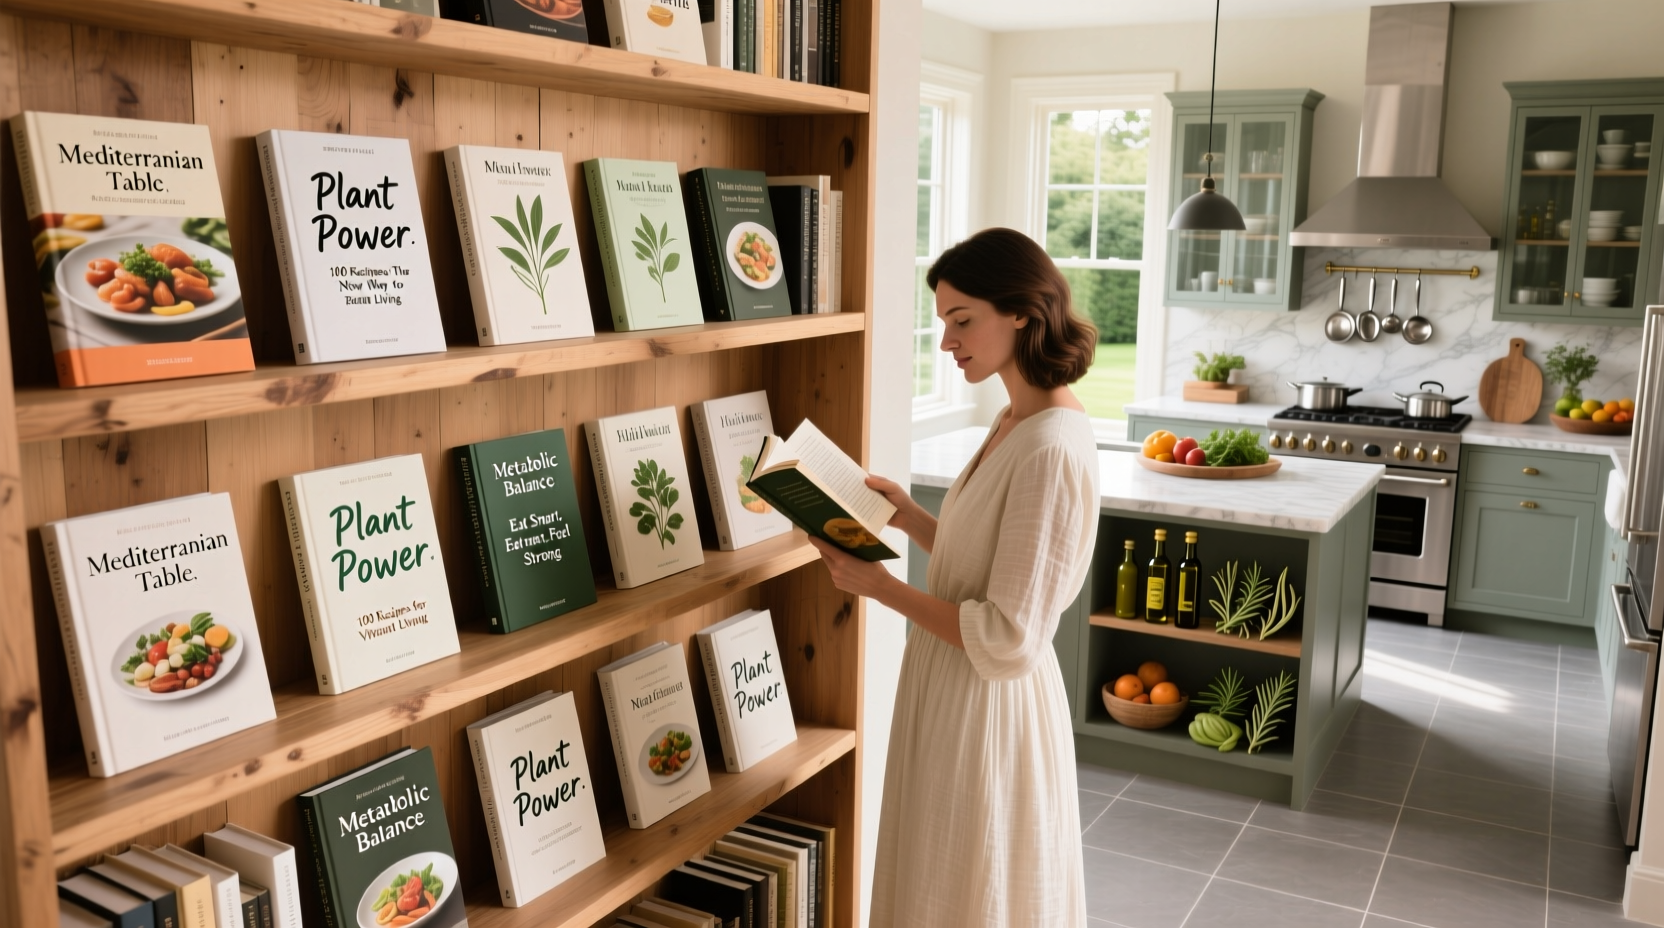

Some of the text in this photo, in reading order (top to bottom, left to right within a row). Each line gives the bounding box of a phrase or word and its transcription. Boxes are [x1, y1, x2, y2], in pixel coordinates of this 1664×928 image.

[310, 170, 399, 211] Plant
[311, 214, 415, 253] Power.
[329, 495, 416, 547] Plant
[134, 563, 198, 592] Table.
[331, 543, 434, 592] Power.
[730, 650, 772, 689] Plant
[510, 740, 570, 791] Plant
[513, 777, 585, 827] Power.
[355, 812, 425, 853] Balance
